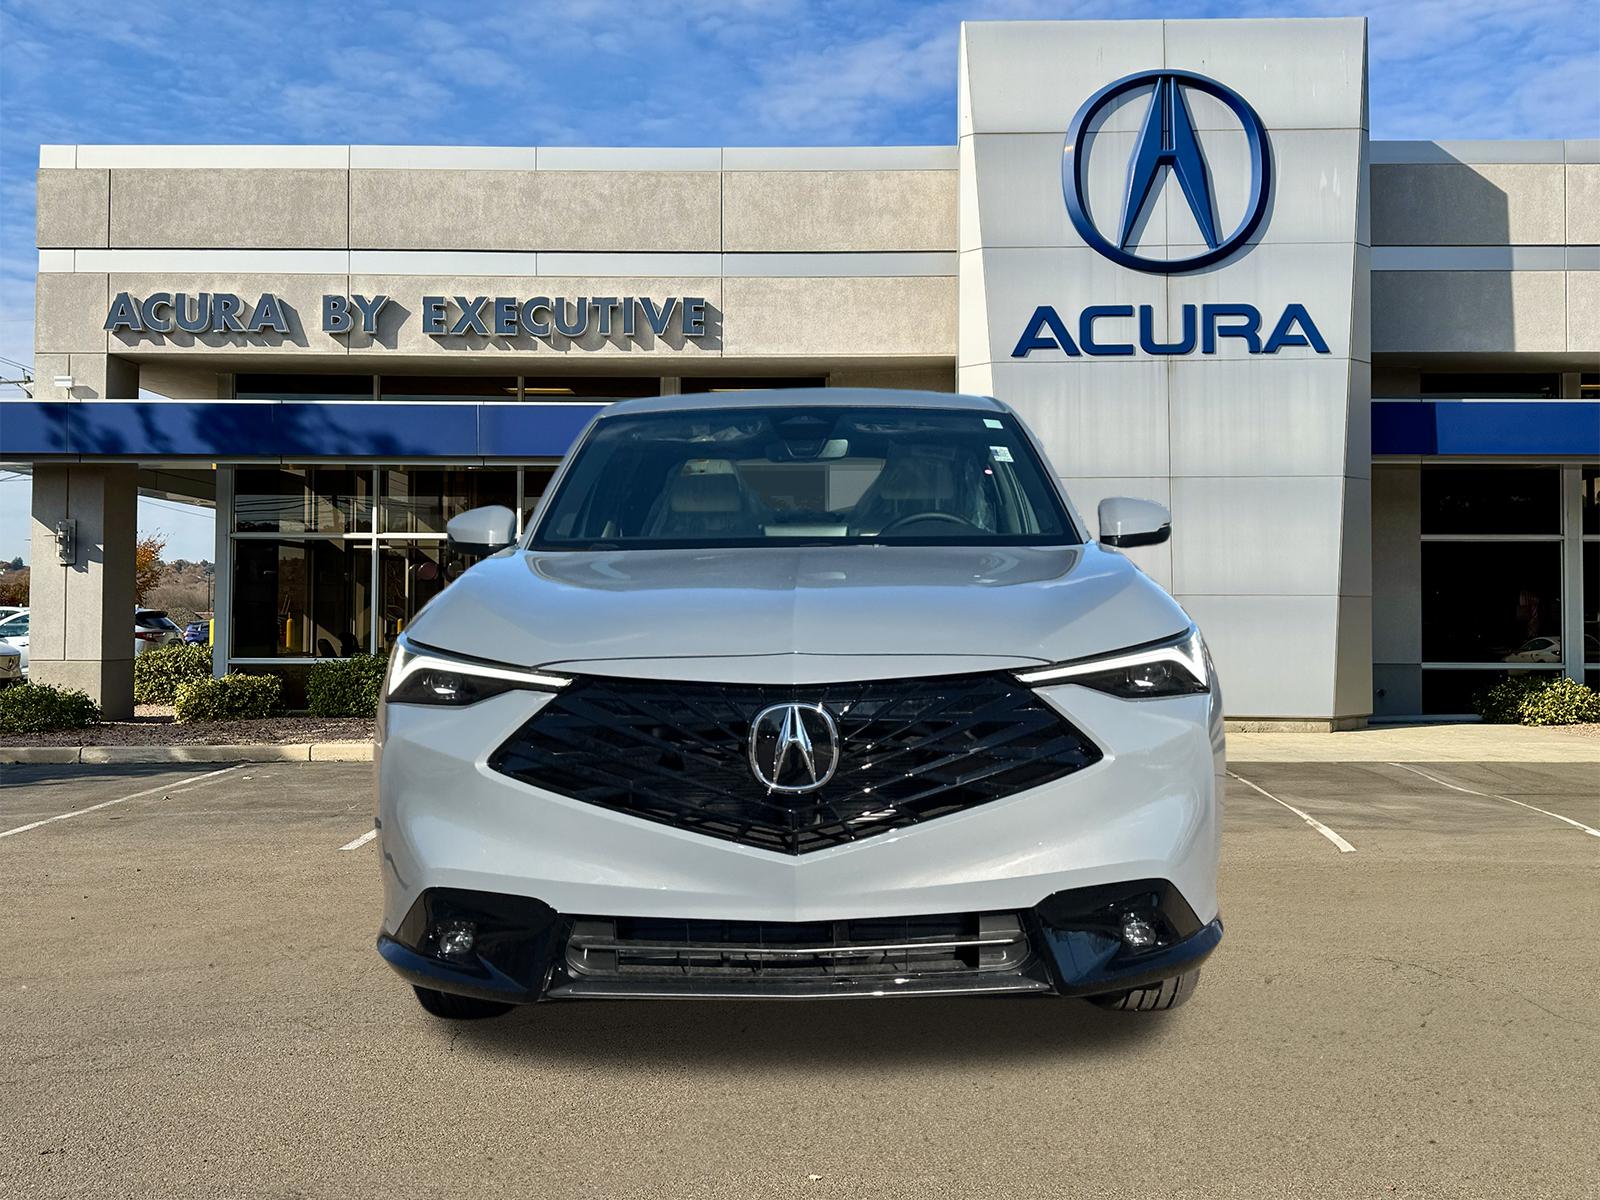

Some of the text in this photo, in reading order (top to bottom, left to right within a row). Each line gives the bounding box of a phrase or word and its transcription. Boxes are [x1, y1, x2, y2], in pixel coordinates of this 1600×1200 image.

[103, 292, 706, 337] ACURA BY EXECUTIVE
[1011, 303, 1332, 357] ACURA
